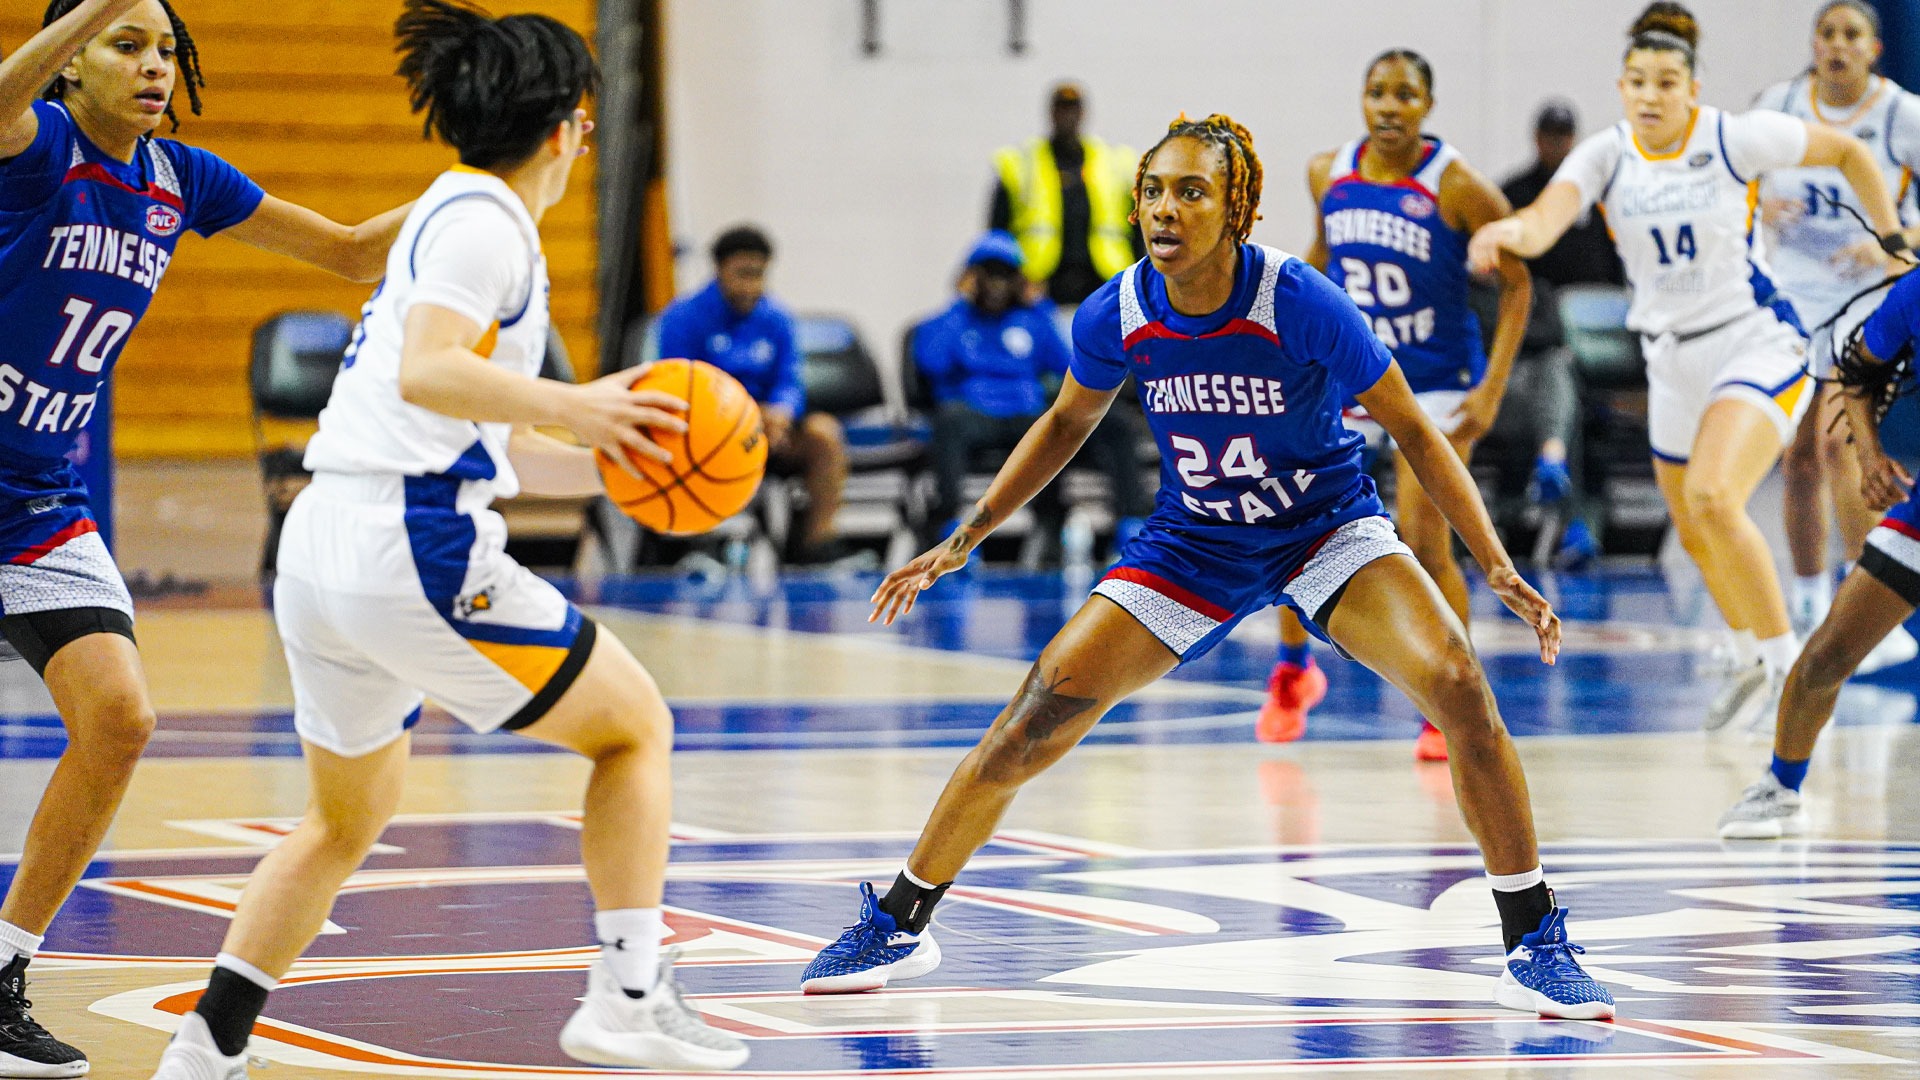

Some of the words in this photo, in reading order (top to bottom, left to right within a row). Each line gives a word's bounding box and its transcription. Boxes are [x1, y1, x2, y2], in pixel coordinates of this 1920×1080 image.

[42, 224, 171, 294] TENNESSE
[1650, 224, 1697, 265] 14
[1340, 256, 1411, 307] 20
[49, 296, 134, 373] 10
[1144, 374, 1286, 415] TENNESSEE
[1171, 435, 1268, 488] 24
